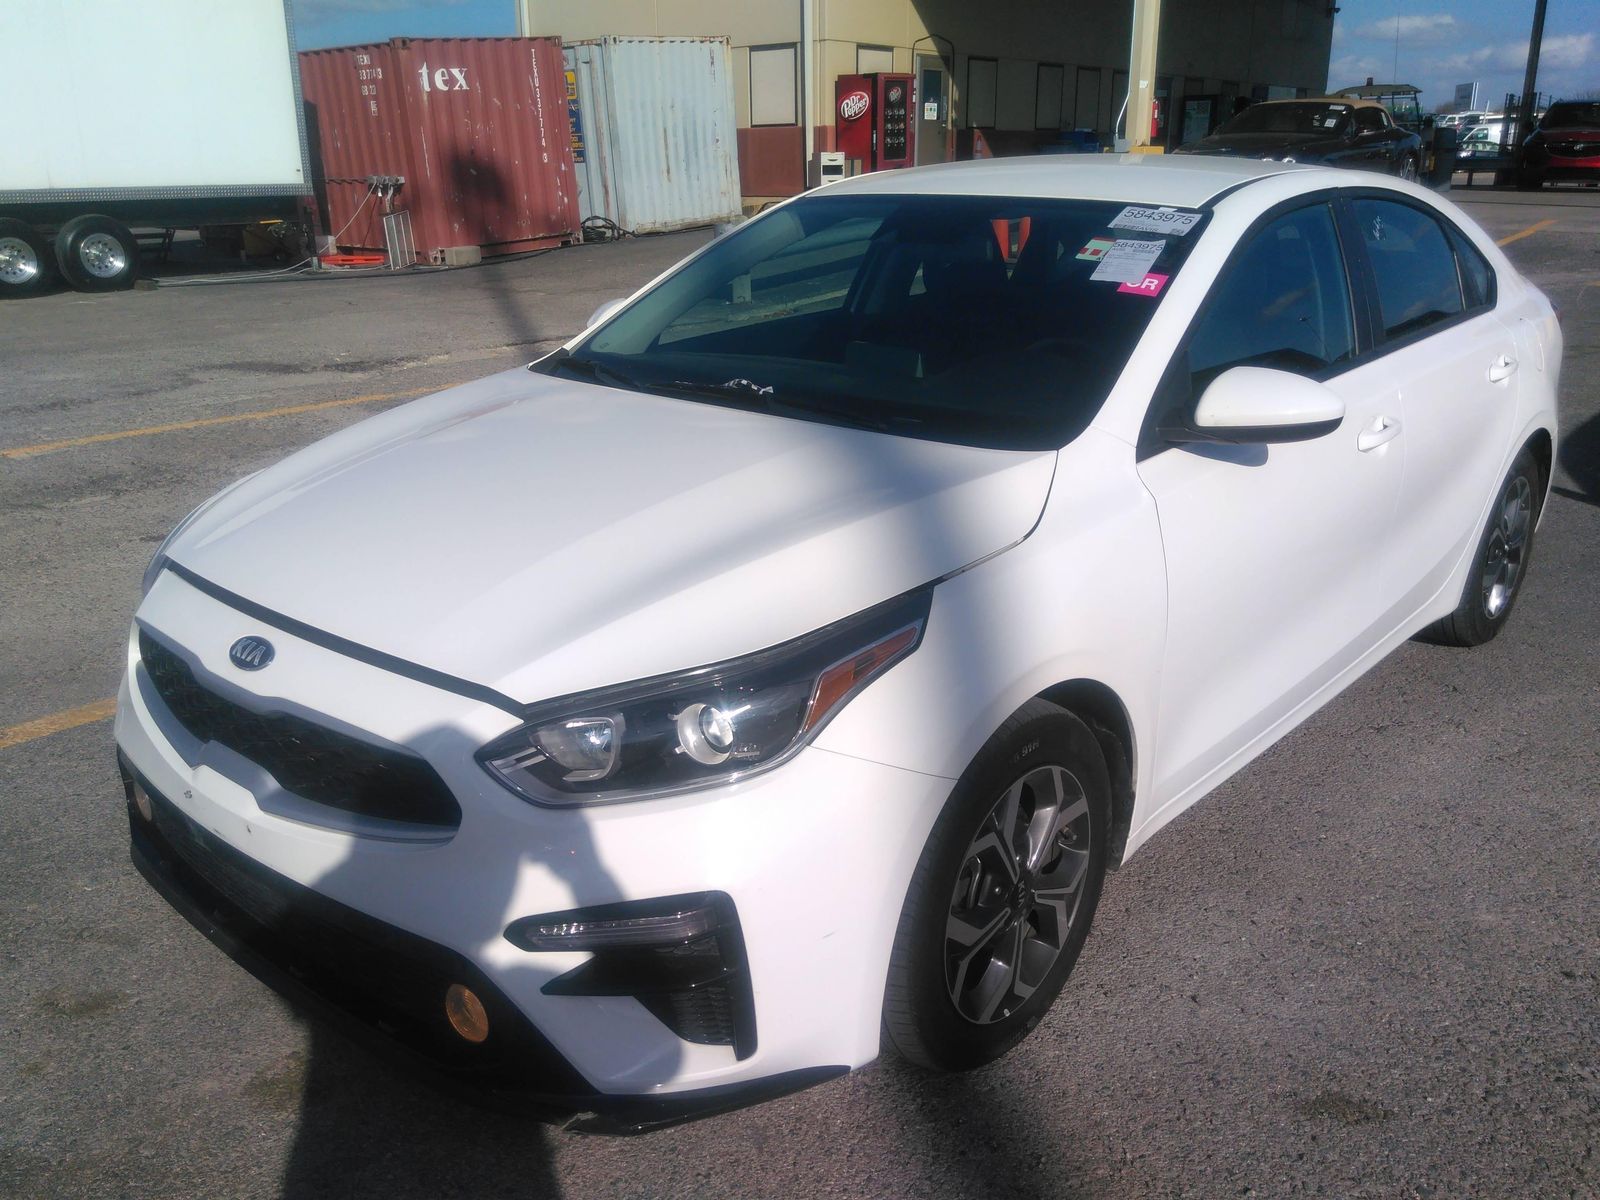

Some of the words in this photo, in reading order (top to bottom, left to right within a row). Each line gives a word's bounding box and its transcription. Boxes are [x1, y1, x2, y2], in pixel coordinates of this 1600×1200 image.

[418, 61, 470, 91] tex
[841, 97, 867, 118] Pepper
[850, 95, 861, 106] Dr
[1124, 208, 1196, 225] 5843975
[1113, 241, 1164, 251] 5843975
[232, 638, 267, 666] KIA
